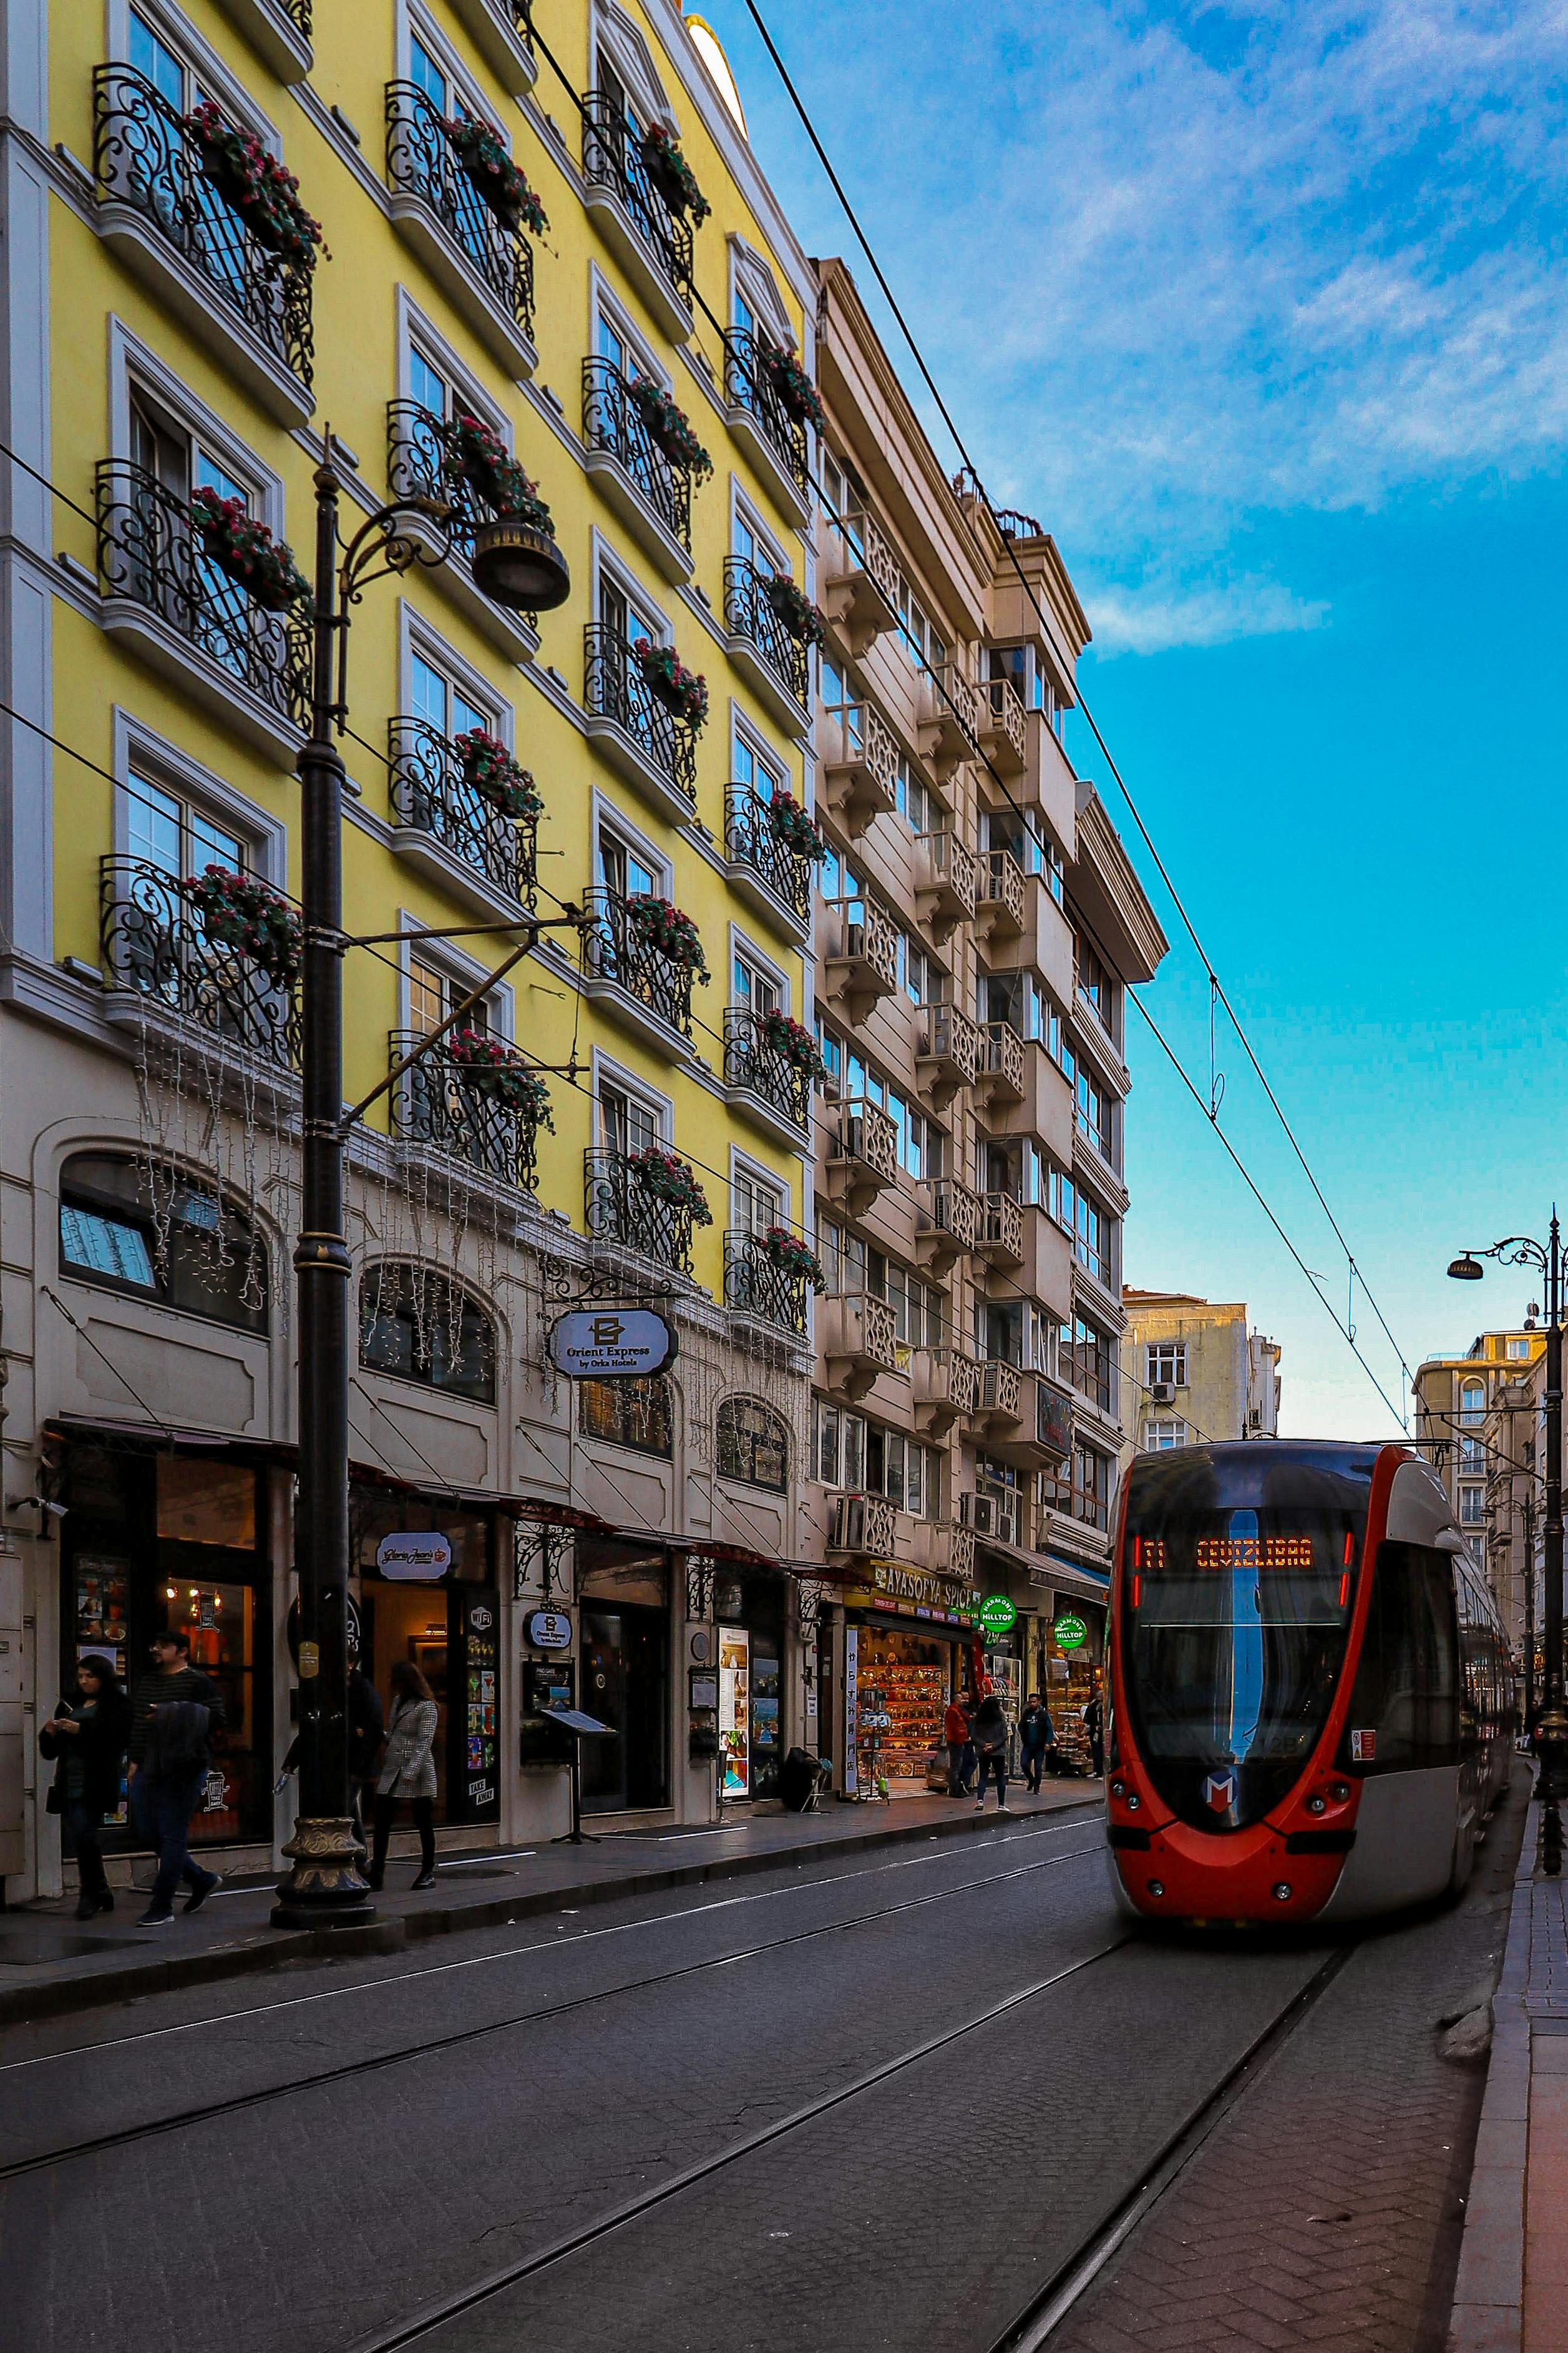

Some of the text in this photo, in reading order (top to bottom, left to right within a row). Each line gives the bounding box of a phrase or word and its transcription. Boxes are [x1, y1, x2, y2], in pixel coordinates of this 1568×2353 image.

[567, 1346, 650, 1360] Orient Express
[580, 1358, 637, 1369] by Orka Hotels
[381, 1548, 434, 1564] Gloria Jean's
[887, 1567, 972, 1610] AYASOFYA SPICE
[983, 1598, 1013, 1612] HARMONY
[478, 1789, 493, 1803] AWAY
